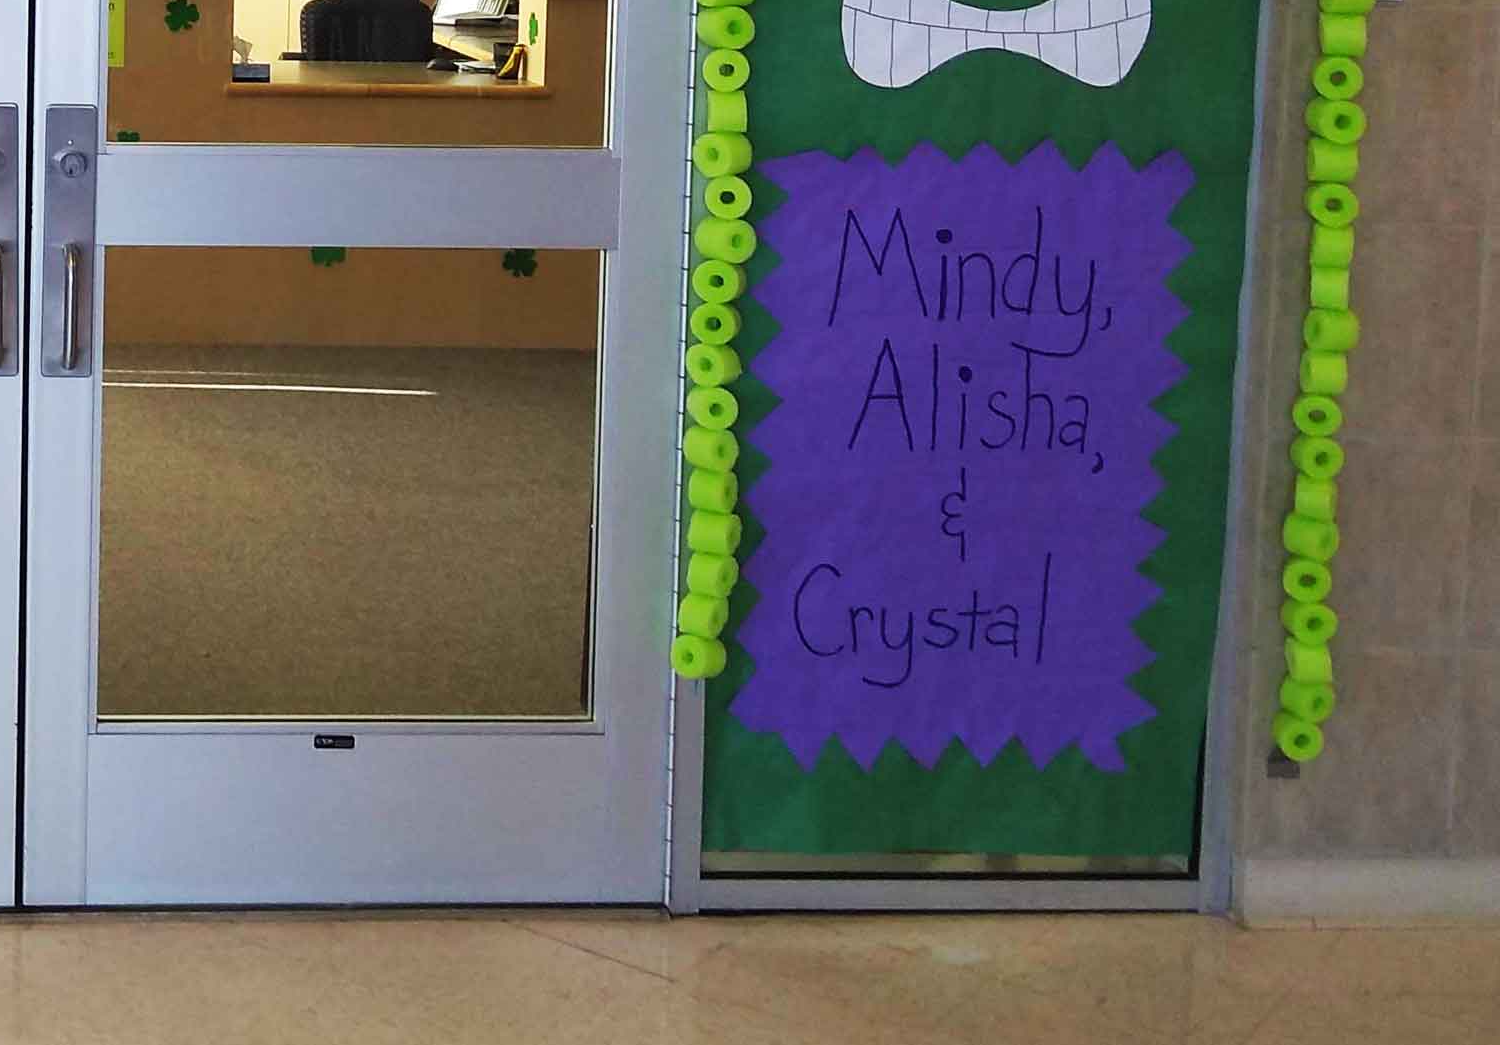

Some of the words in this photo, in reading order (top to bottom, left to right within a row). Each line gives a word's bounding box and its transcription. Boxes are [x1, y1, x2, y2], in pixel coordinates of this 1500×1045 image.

[827, 206, 1113, 357] Mindy,
[848, 338, 1104, 474] Alisha,
[941, 467, 967, 562] &
[794, 552, 1052, 688] Crystal
